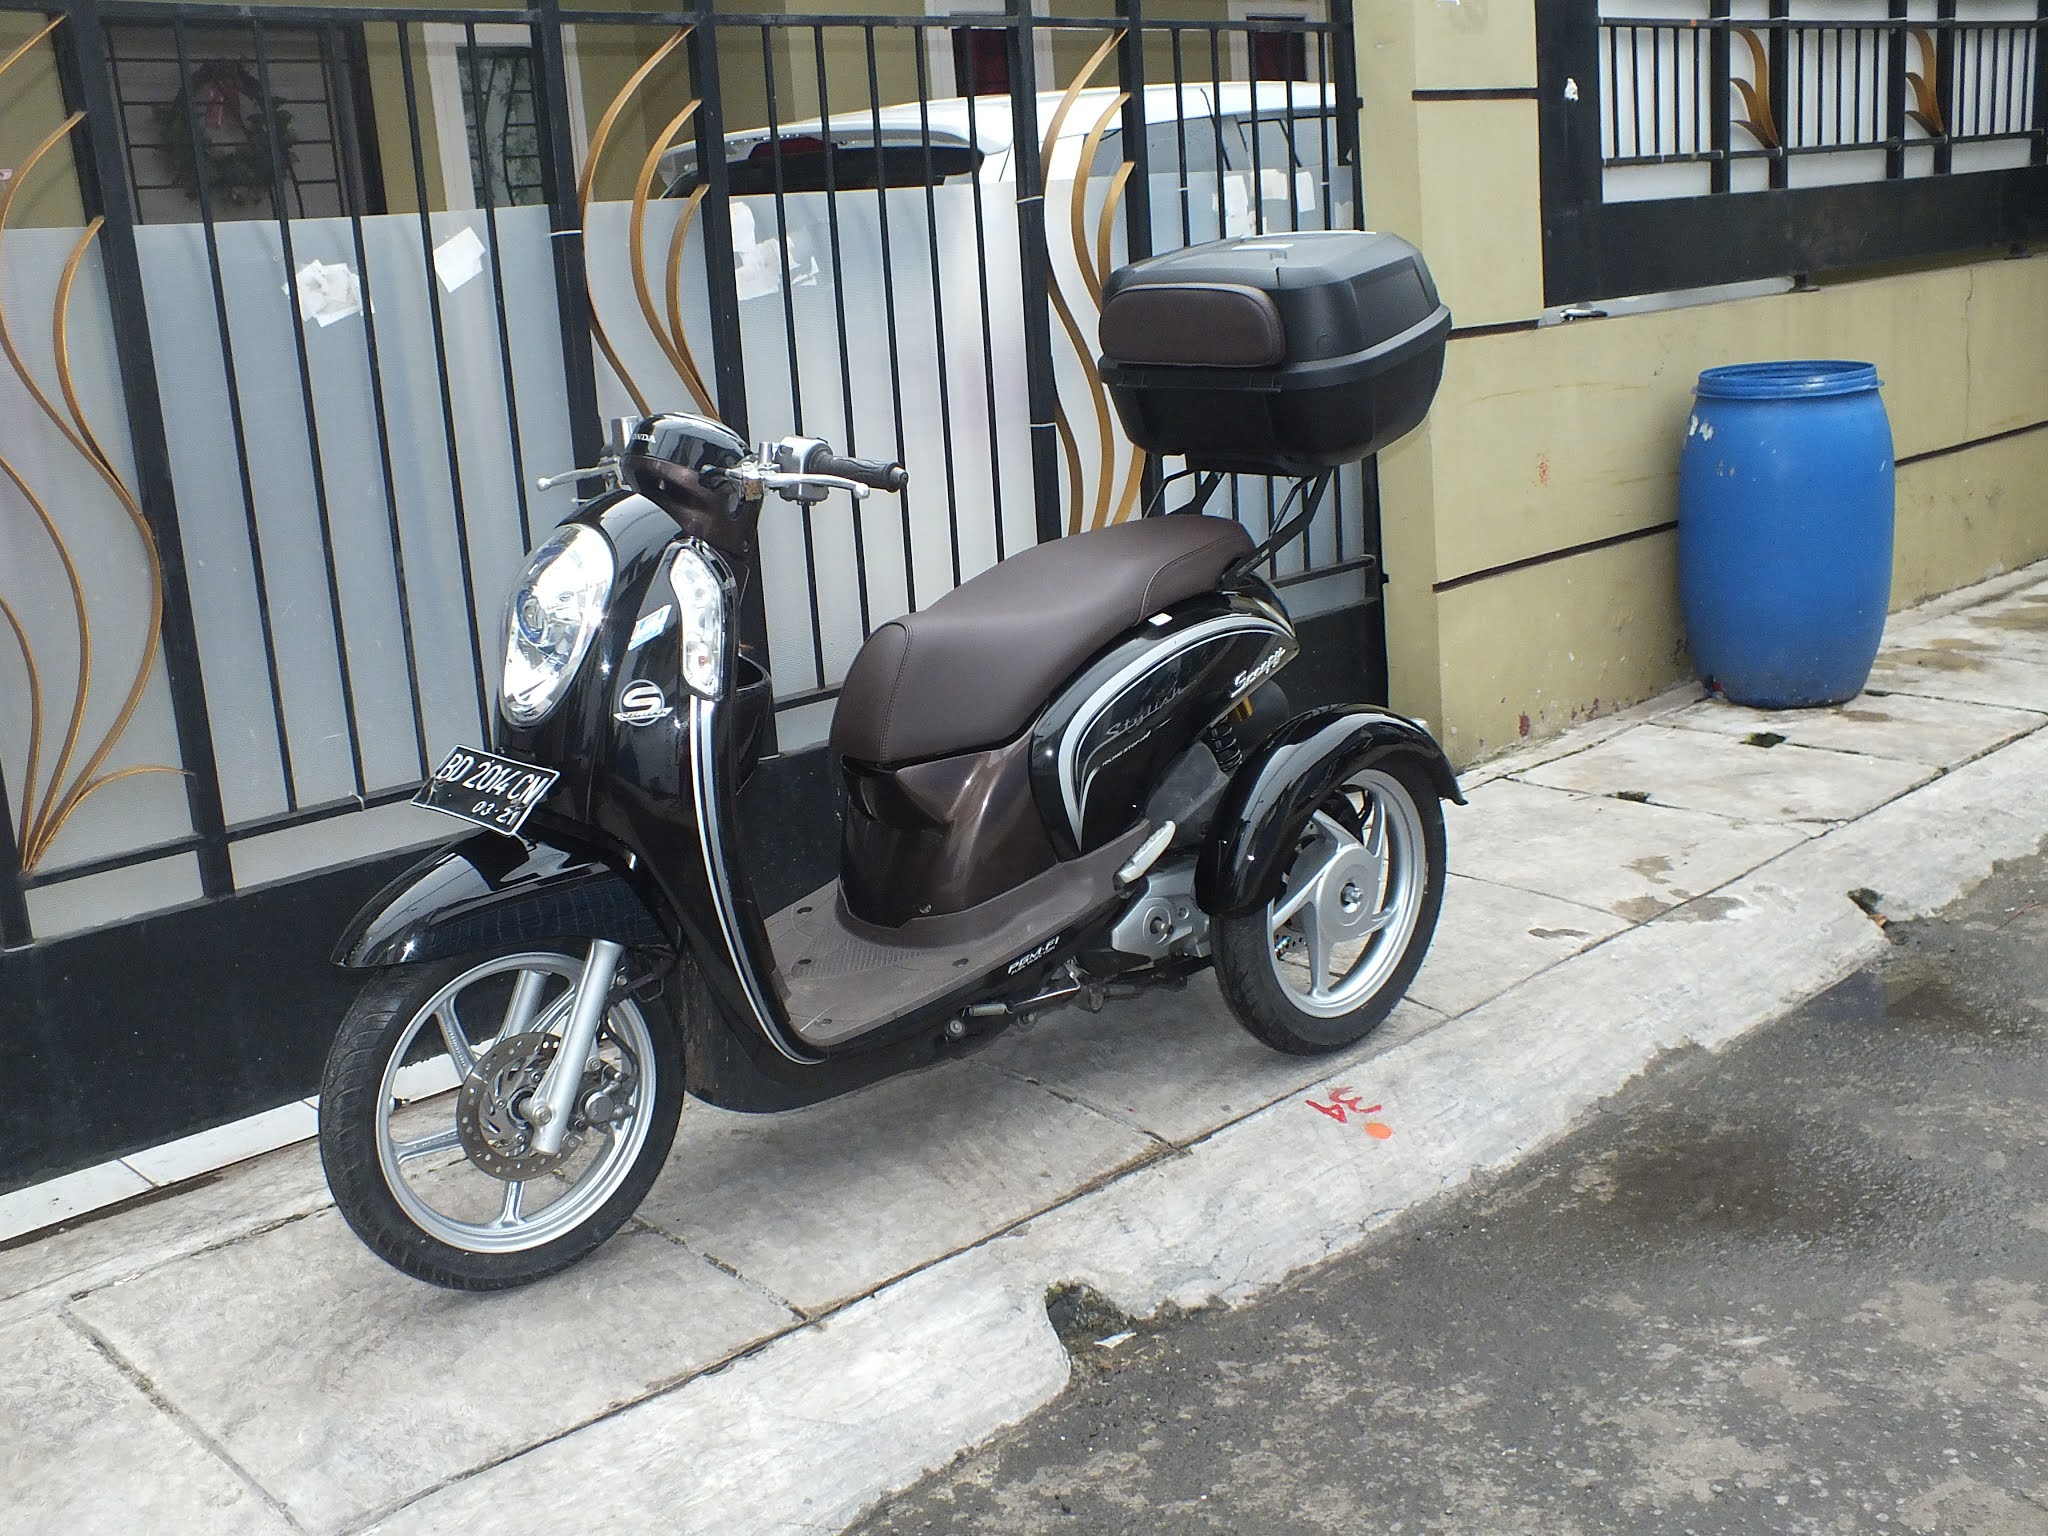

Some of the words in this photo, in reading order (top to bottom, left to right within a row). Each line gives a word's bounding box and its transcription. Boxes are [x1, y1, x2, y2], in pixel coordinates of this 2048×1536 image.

[435, 753, 475, 782] BD
[462, 760, 522, 796] 2014
[507, 774, 550, 805] CN
